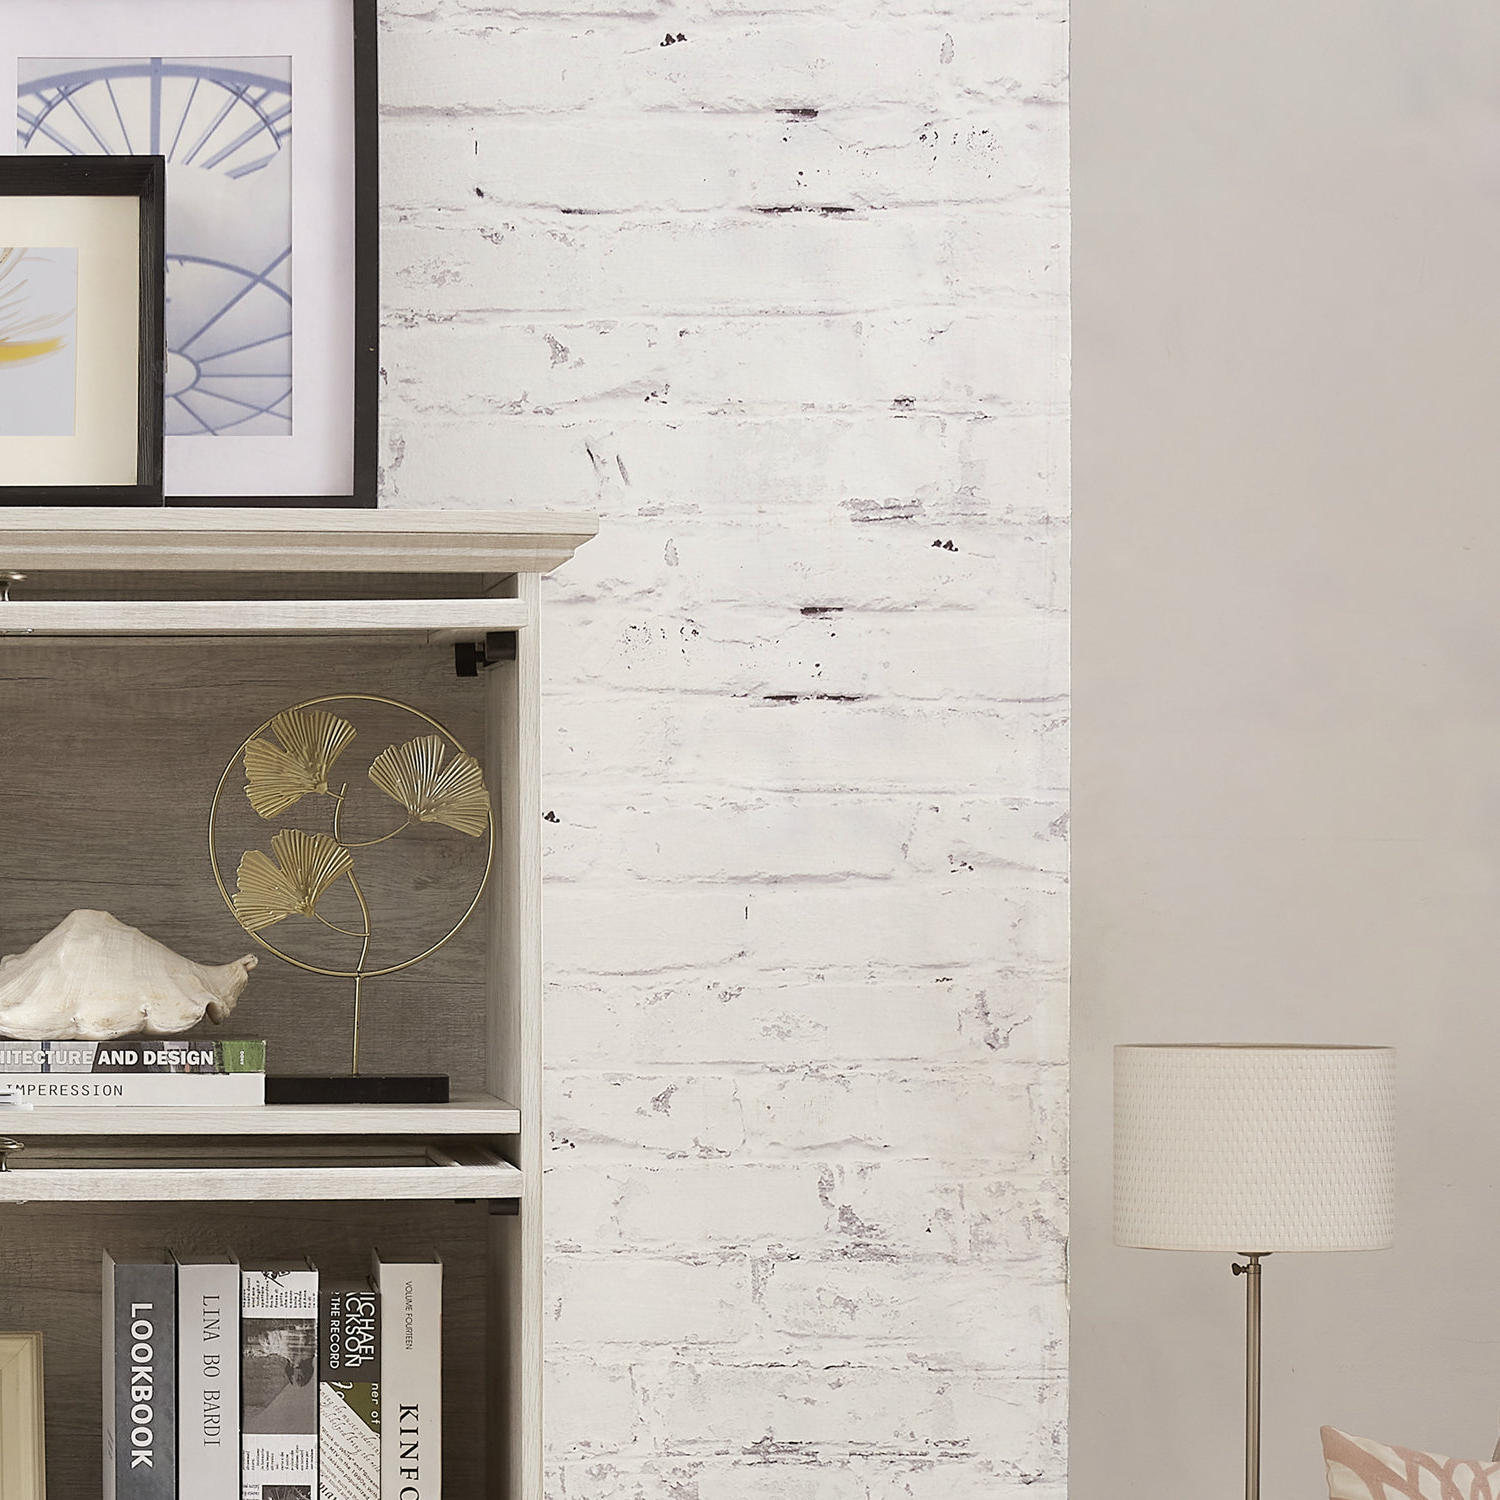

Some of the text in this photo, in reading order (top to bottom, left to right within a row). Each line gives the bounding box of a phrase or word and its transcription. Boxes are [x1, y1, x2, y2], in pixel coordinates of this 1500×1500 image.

[98, 1050, 138, 1066] AND
[142, 1050, 214, 1066] DESIGN
[330, 1298, 341, 1369] THE RECORD
[405, 1313, 413, 1350] FOURTEEN
[131, 1304, 153, 1468] LOOKBOOK
[203, 1296, 220, 1447] LINA BO BARDI
[371, 1411, 380, 1425] of
